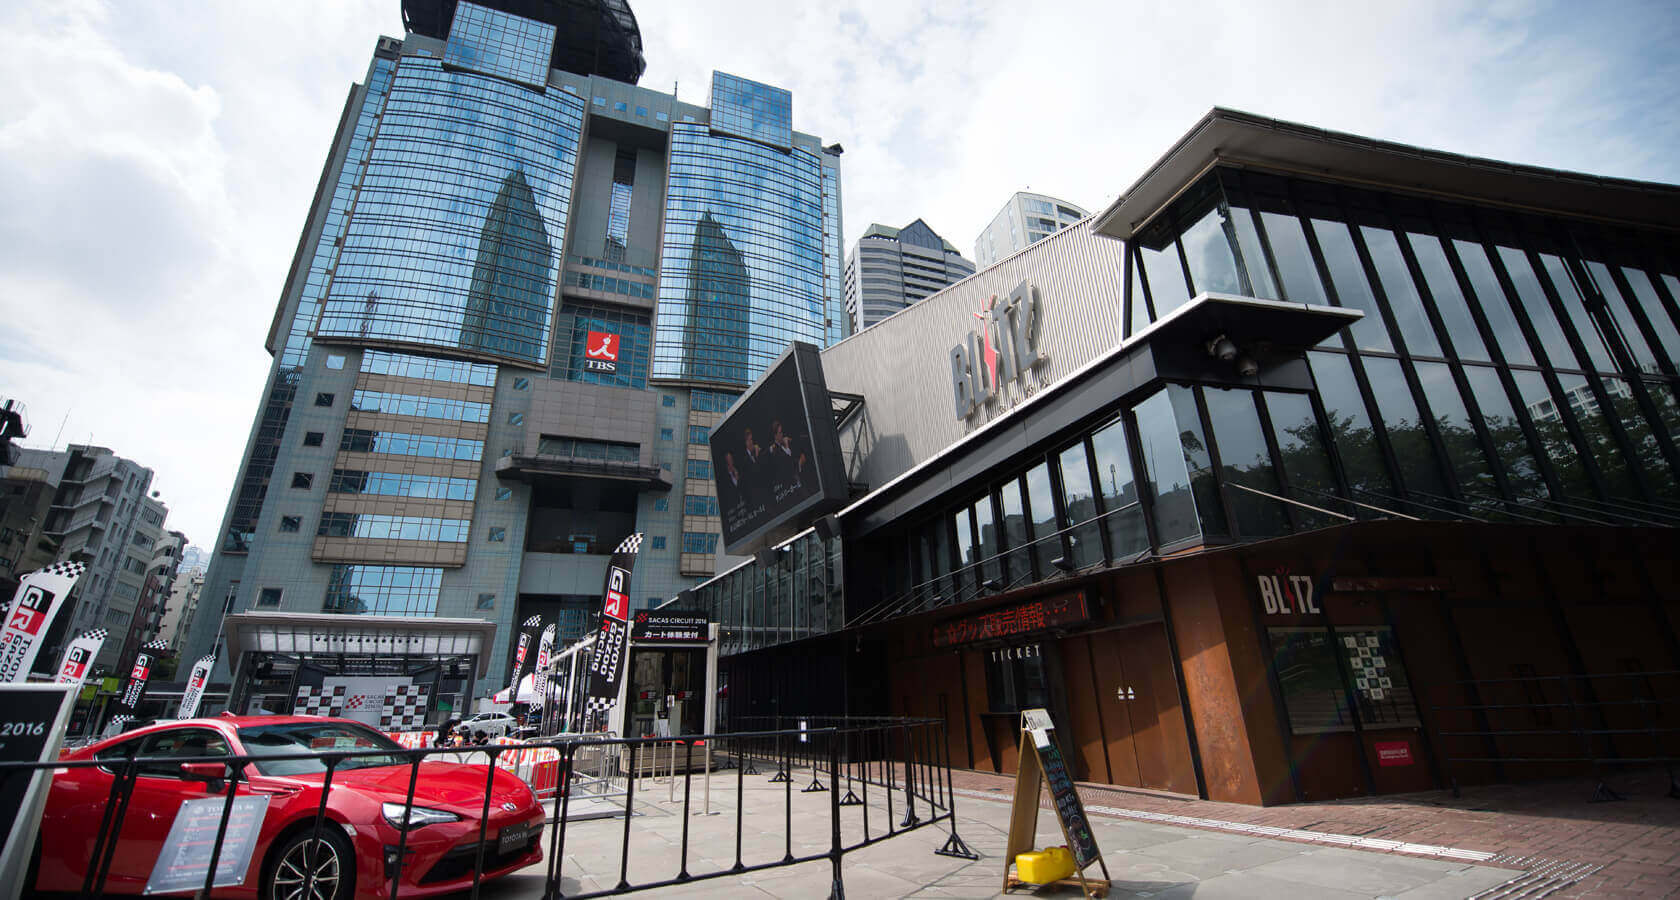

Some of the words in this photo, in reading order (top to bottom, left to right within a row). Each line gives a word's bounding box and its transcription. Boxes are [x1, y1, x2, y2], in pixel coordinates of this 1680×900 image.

[586, 359, 616, 371] TBS
[950, 279, 1039, 421] BLITZ
[10, 586, 43, 630] GR
[606, 568, 624, 616] GR
[1257, 573, 1321, 615] BLITZ
[63, 647, 84, 675] GR
[133, 655, 148, 678] GR
[591, 620, 611, 672] Racing
[600, 622, 617, 675] GAZOO
[607, 624, 625, 683] TOYOTA
[991, 645, 1040, 663] TICKET
[0, 722, 45, 736] 2016
